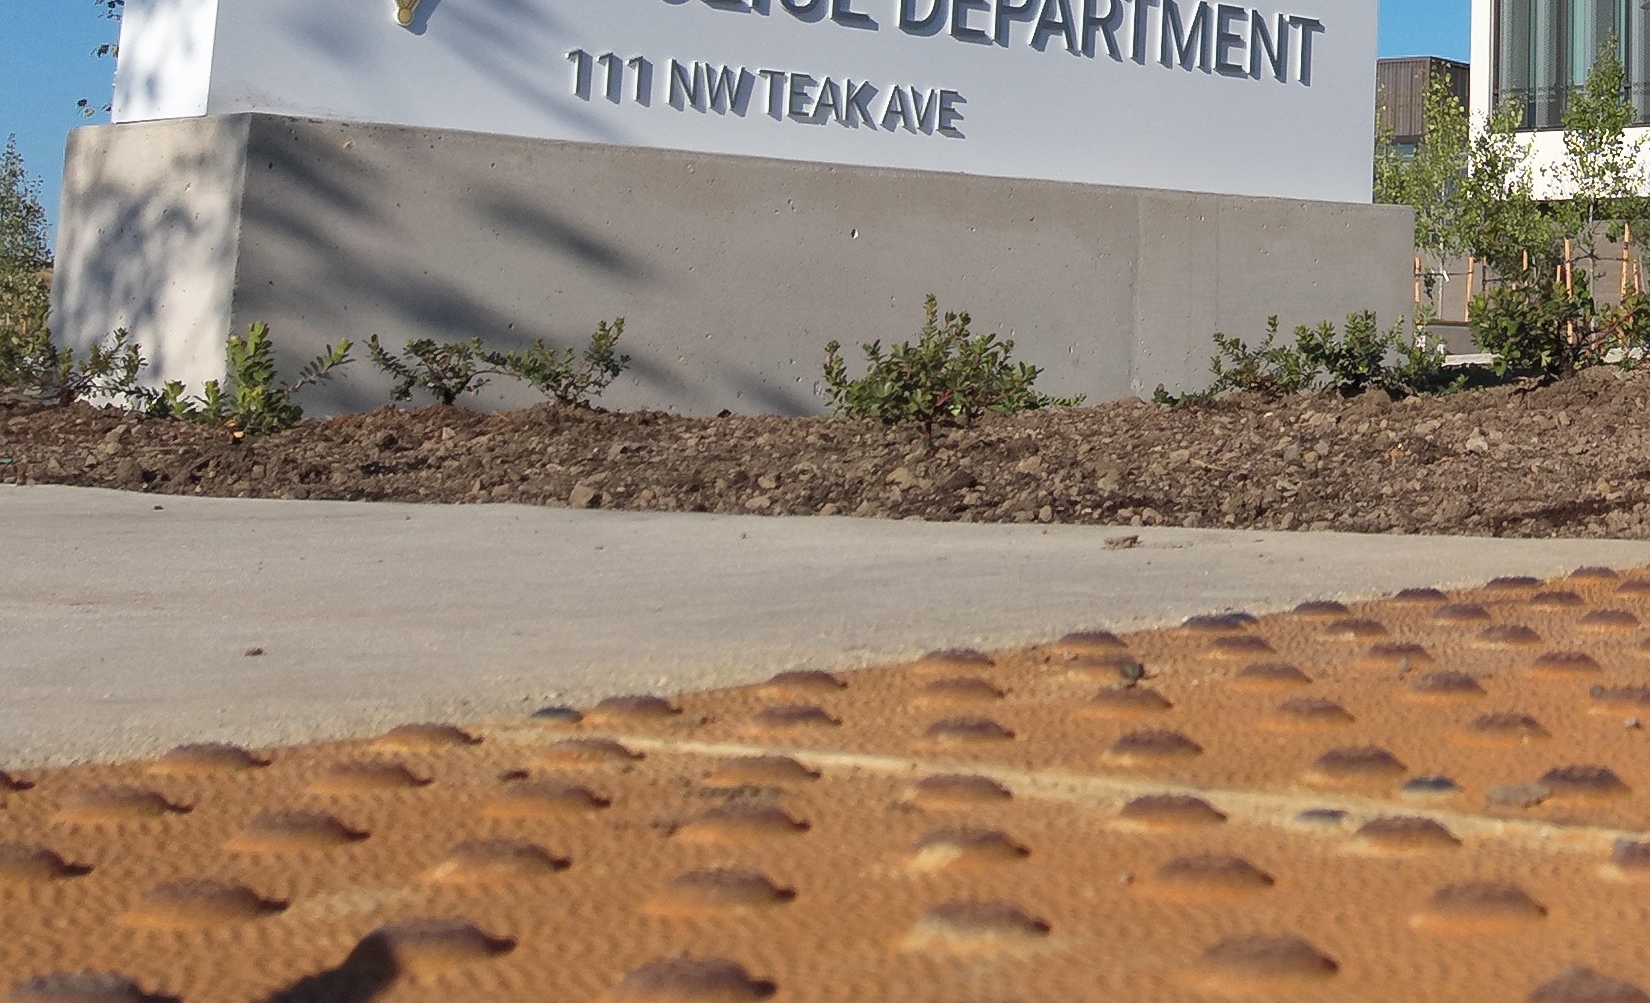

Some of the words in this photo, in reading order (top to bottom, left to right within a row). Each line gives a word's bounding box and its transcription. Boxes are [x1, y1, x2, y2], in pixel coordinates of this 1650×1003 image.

[564, 49, 645, 101] 111
[667, 58, 748, 111] NW
[757, 69, 871, 126] TEAK
[879, 83, 959, 132] AVE
